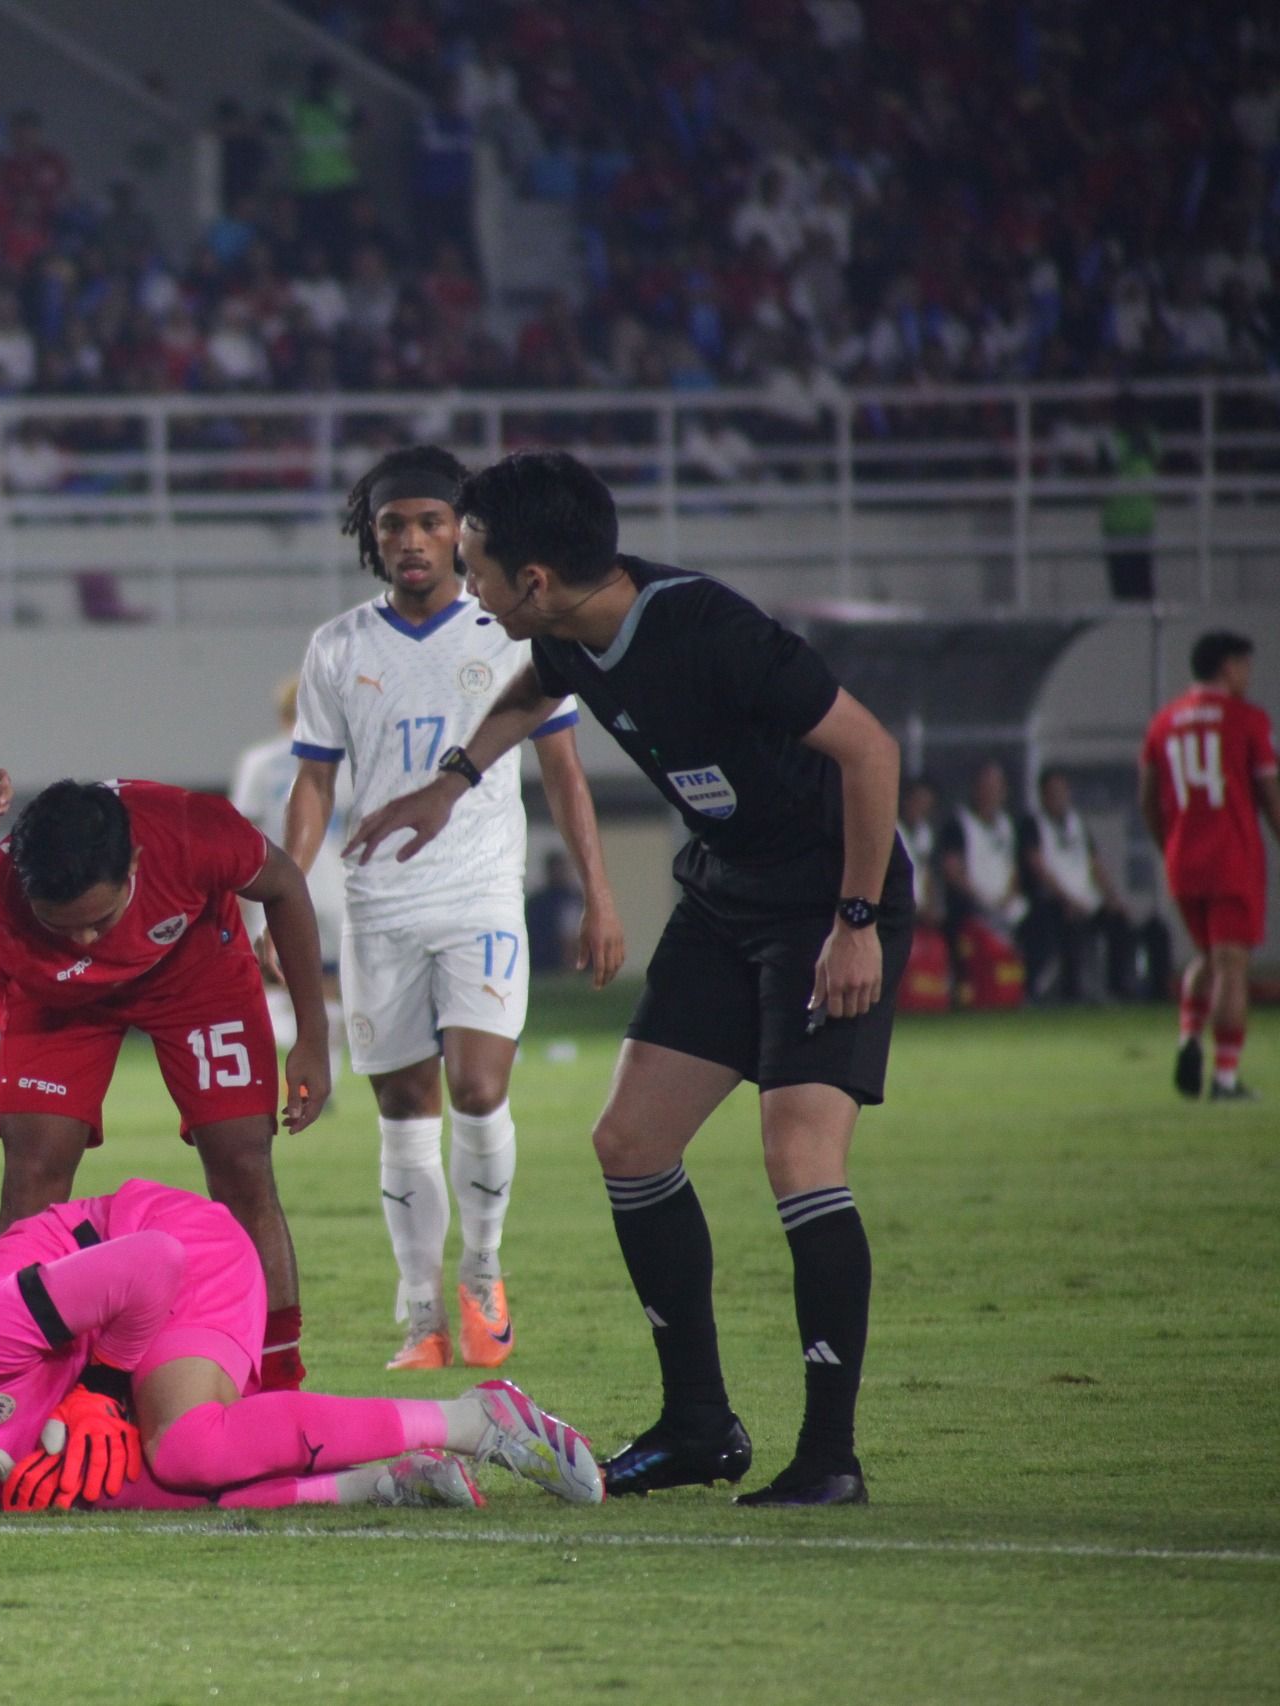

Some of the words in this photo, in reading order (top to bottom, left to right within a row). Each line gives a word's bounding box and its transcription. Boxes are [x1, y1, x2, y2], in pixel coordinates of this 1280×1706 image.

[395, 716, 445, 772] 17
[674, 771, 721, 788] FIFA
[1166, 731, 1225, 811] 14
[686, 790, 730, 801] REFEREE
[57, 956, 93, 982] erspo
[477, 931, 518, 980] 17
[187, 1020, 251, 1091] 15
[18, 1076, 67, 1096] erspo
